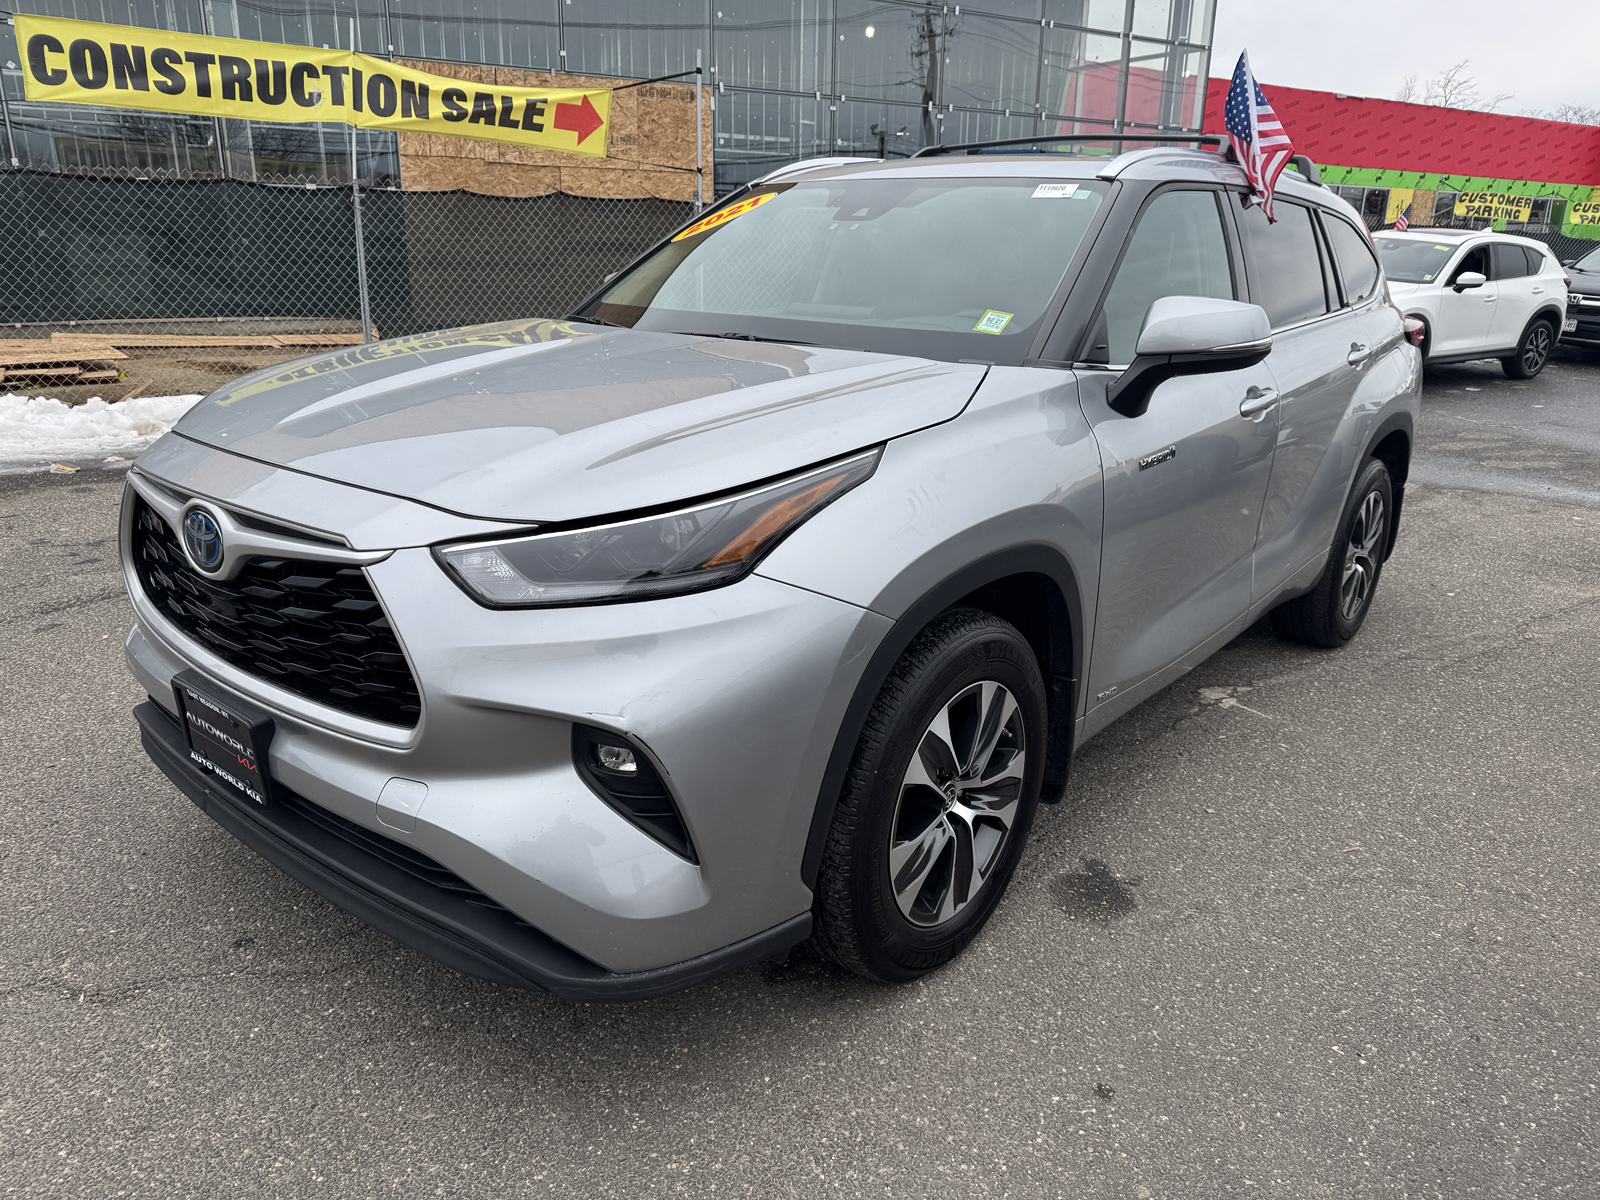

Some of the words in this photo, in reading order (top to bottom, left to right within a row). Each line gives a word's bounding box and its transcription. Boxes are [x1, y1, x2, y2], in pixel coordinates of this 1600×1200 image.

[27, 33, 430, 120] CONSTRUCTION
[441, 88, 548, 133] SALE
[1458, 192, 1532, 208] CUSTOMER
[682, 197, 762, 238] 2021
[1465, 204, 1522, 220] PARKING
[1139, 450, 1171, 472] HYBRID
[238, 754, 258, 774] KIA
[190, 752, 212, 770] AUTO
[214, 765, 245, 791] WORLD
[245, 787, 263, 805] KIA
